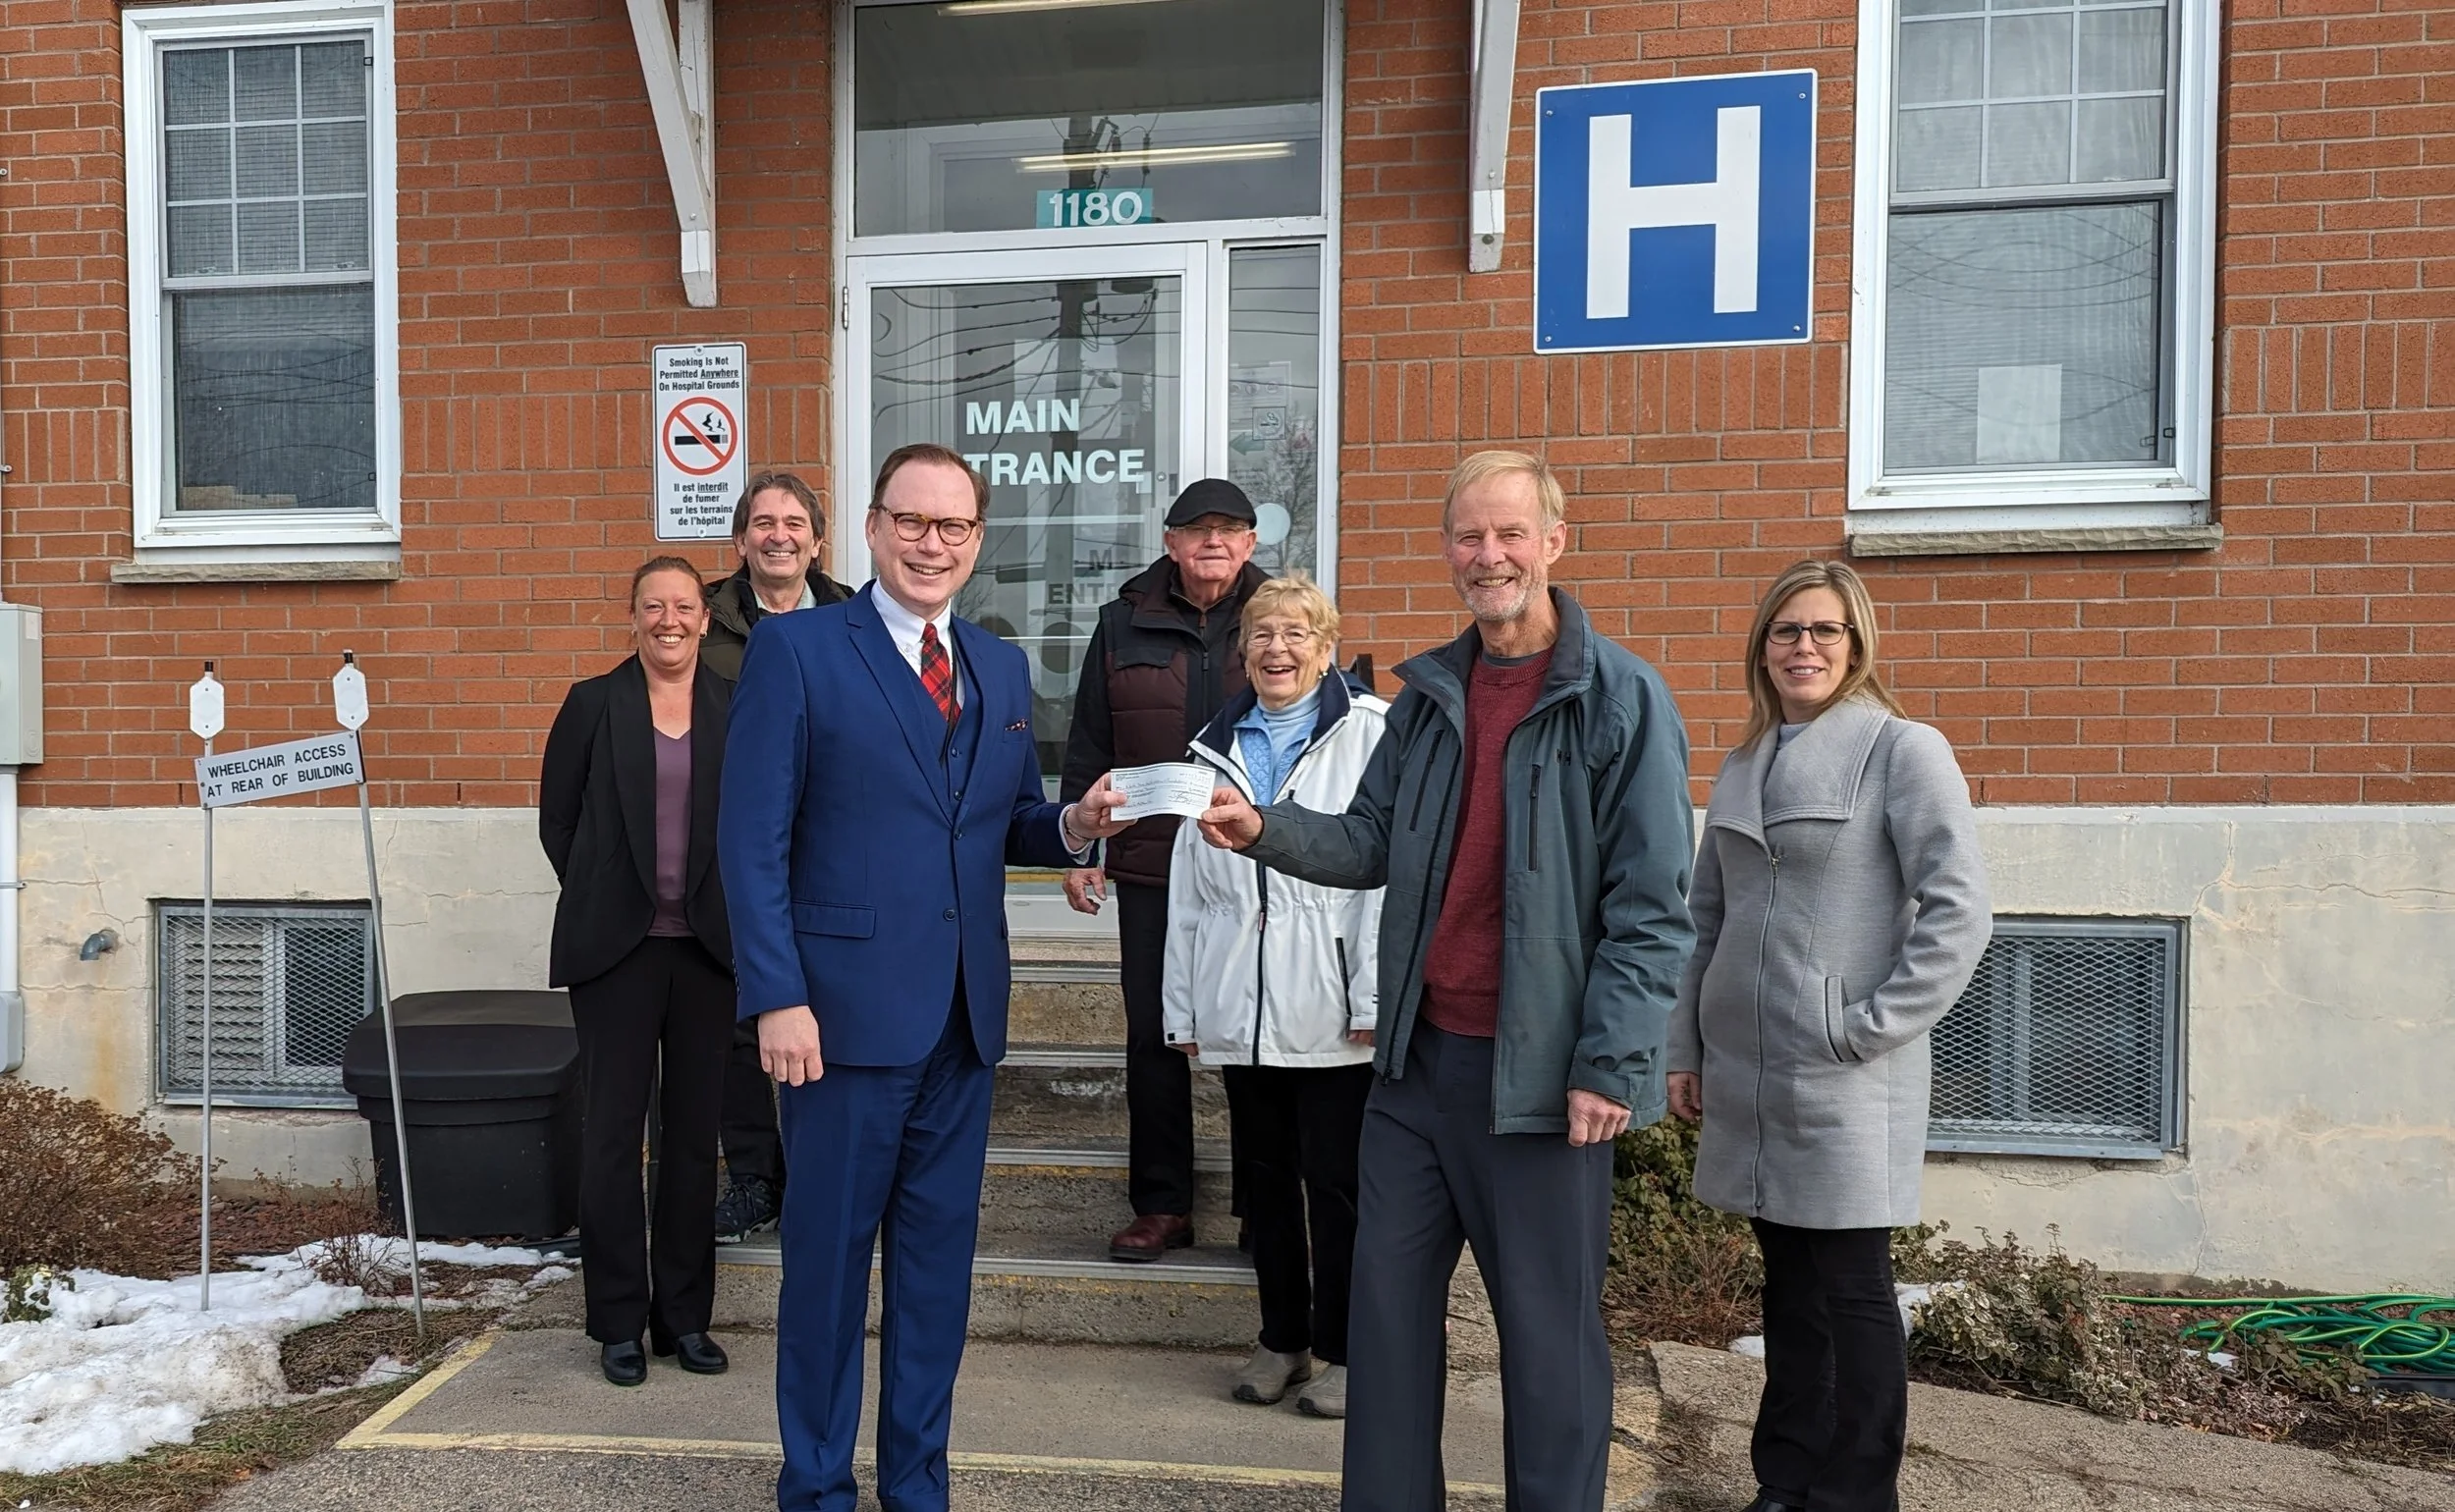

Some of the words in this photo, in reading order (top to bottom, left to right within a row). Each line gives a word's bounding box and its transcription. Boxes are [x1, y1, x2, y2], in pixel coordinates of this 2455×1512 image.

[1049, 191, 1142, 227] 1180
[1586, 105, 1761, 319] H
[670, 357, 703, 367] Smoking
[705, 357, 712, 366] Is
[715, 356, 729, 365] Not
[659, 369, 698, 379] Permitted
[700, 368, 738, 379] Anywhere
[659, 382, 670, 391] On
[672, 381, 704, 392] Hospital
[707, 380, 739, 390] Grounds
[966, 399, 1079, 435] MAIN
[674, 483, 680, 492] Il
[682, 483, 695, 492] est
[697, 482, 729, 493] interdit
[682, 494, 693, 503] de
[695, 494, 720, 503] fumer
[685, 505, 698, 514] les
[699, 504, 734, 514] terrains
[678, 516, 688, 526] de
[207, 754, 286, 779] WHEELCHAIR
[295, 743, 346, 764] ACCESS
[207, 783, 223, 798] AT
[231, 777, 264, 793] REAR
[272, 773, 289, 786] OF
[298, 762, 354, 783] BUILDING
